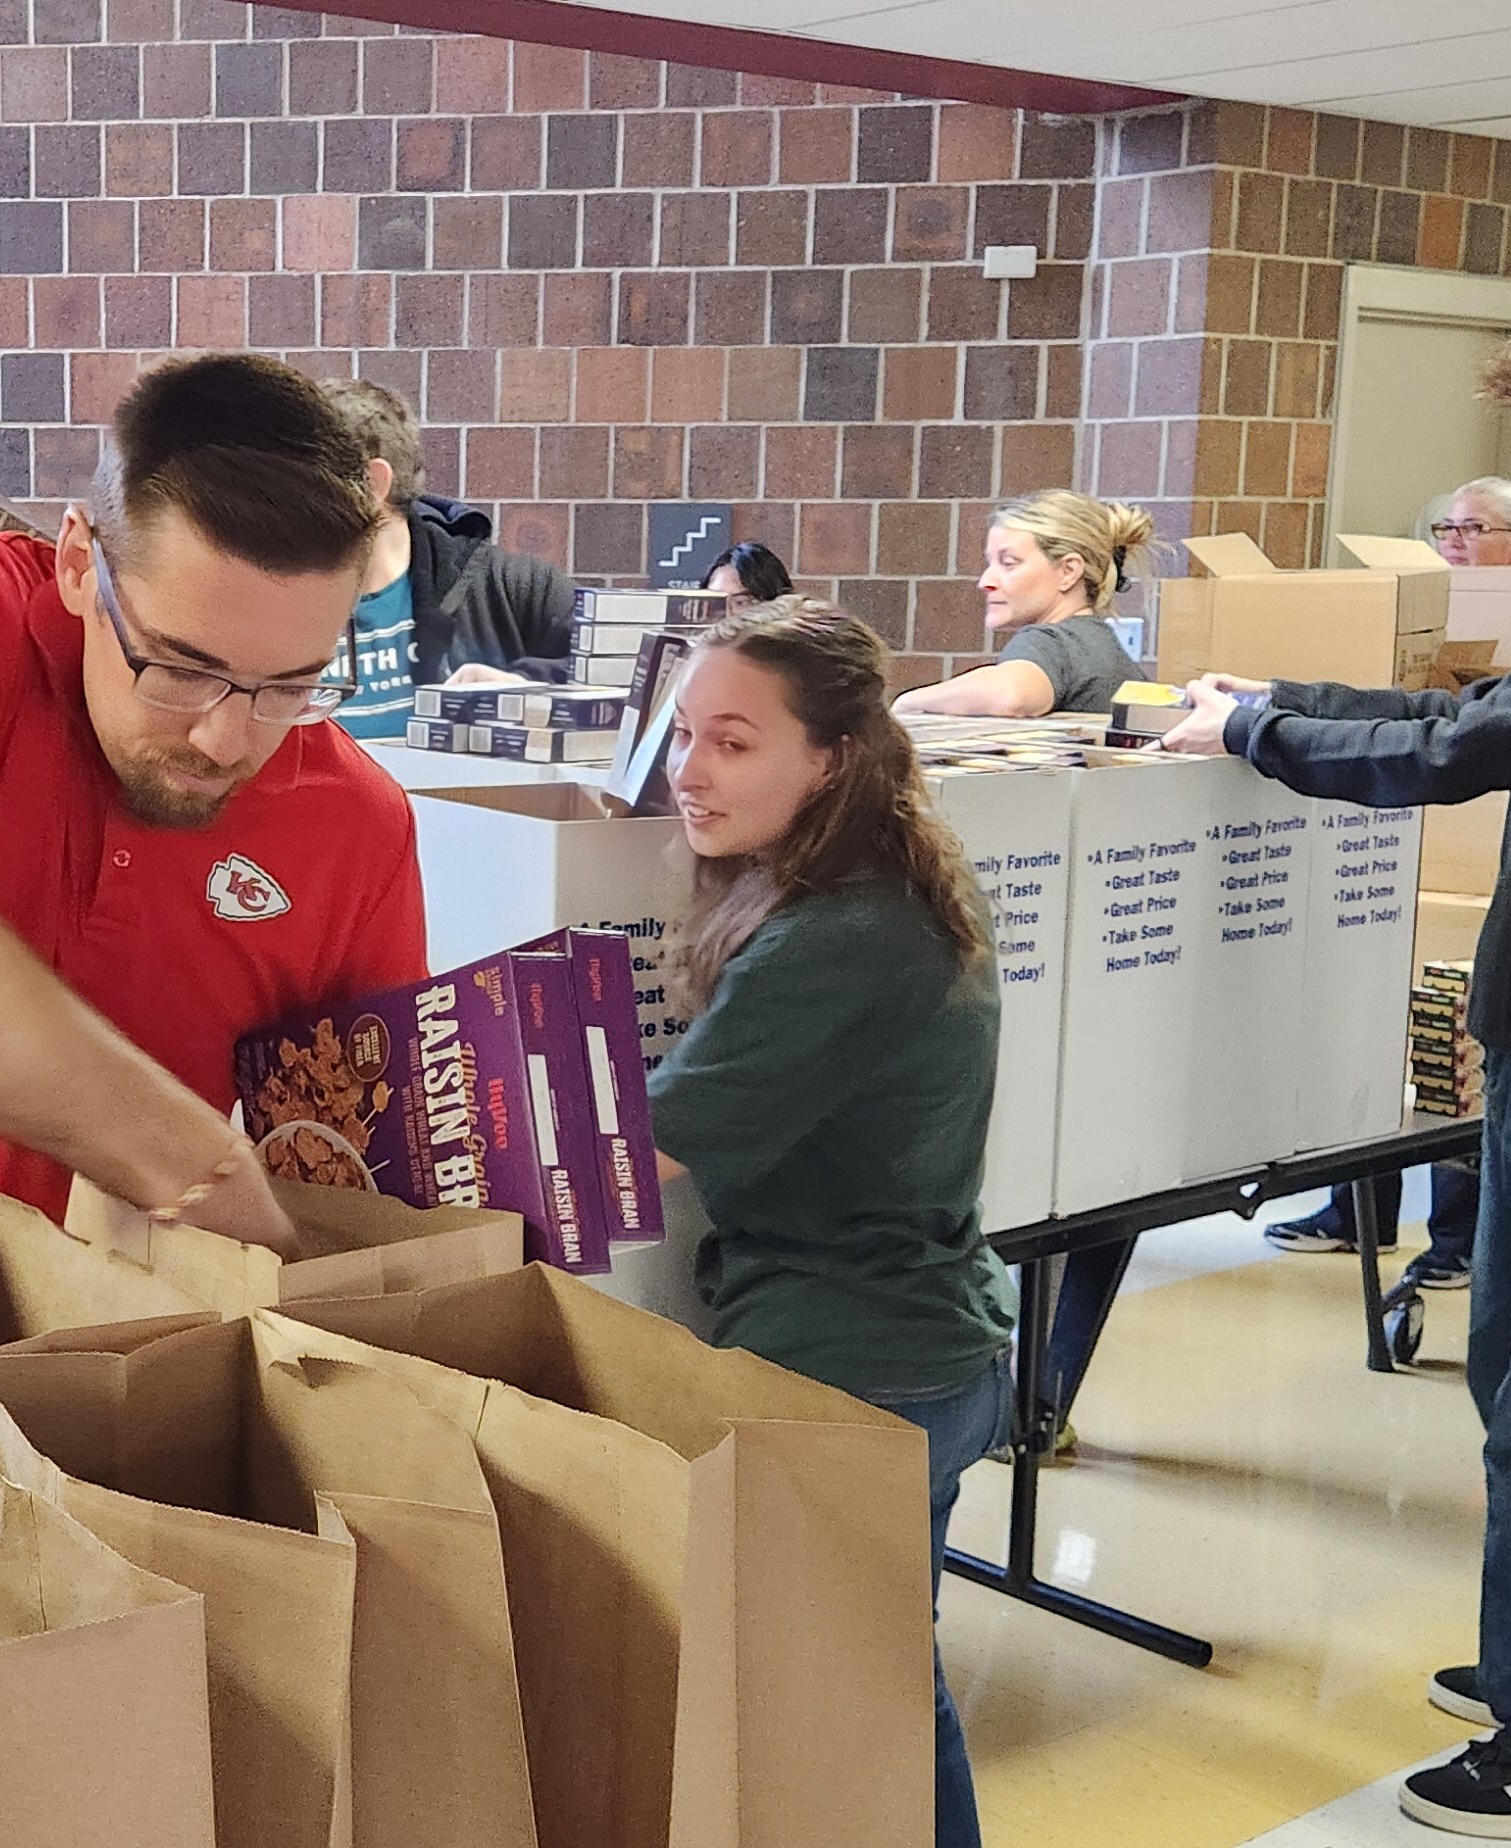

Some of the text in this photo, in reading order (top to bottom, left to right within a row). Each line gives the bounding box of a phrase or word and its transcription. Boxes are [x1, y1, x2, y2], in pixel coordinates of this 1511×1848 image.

[1224, 821, 1262, 840] Family
[1265, 816, 1307, 834] Favorite
[1337, 812, 1369, 829] Family
[1373, 808, 1414, 825] Favorite
[1006, 851, 1061, 871] Favorite
[1107, 845, 1146, 864] Family
[1149, 839, 1197, 858] Favorite
[1229, 848, 1261, 864] Great
[1372, 859, 1398, 874] Price
[1112, 868, 1181, 890] Great Taste
[1227, 870, 1288, 890] Great Price
[226, 870, 271, 912] KC
[1006, 881, 1042, 899] Taste
[1111, 895, 1177, 918] Great Price
[1224, 902, 1252, 916] Take
[1005, 910, 1039, 928] Price
[1108, 924, 1173, 945] Take Some
[1107, 946, 1182, 972] Home Today!
[1002, 962, 1045, 983] Today!
[416, 984, 470, 1146] RAISIN
[611, 1137, 640, 1229] RAISIN BRAN
[551, 1168, 582, 1263] RAISIN BRAN
